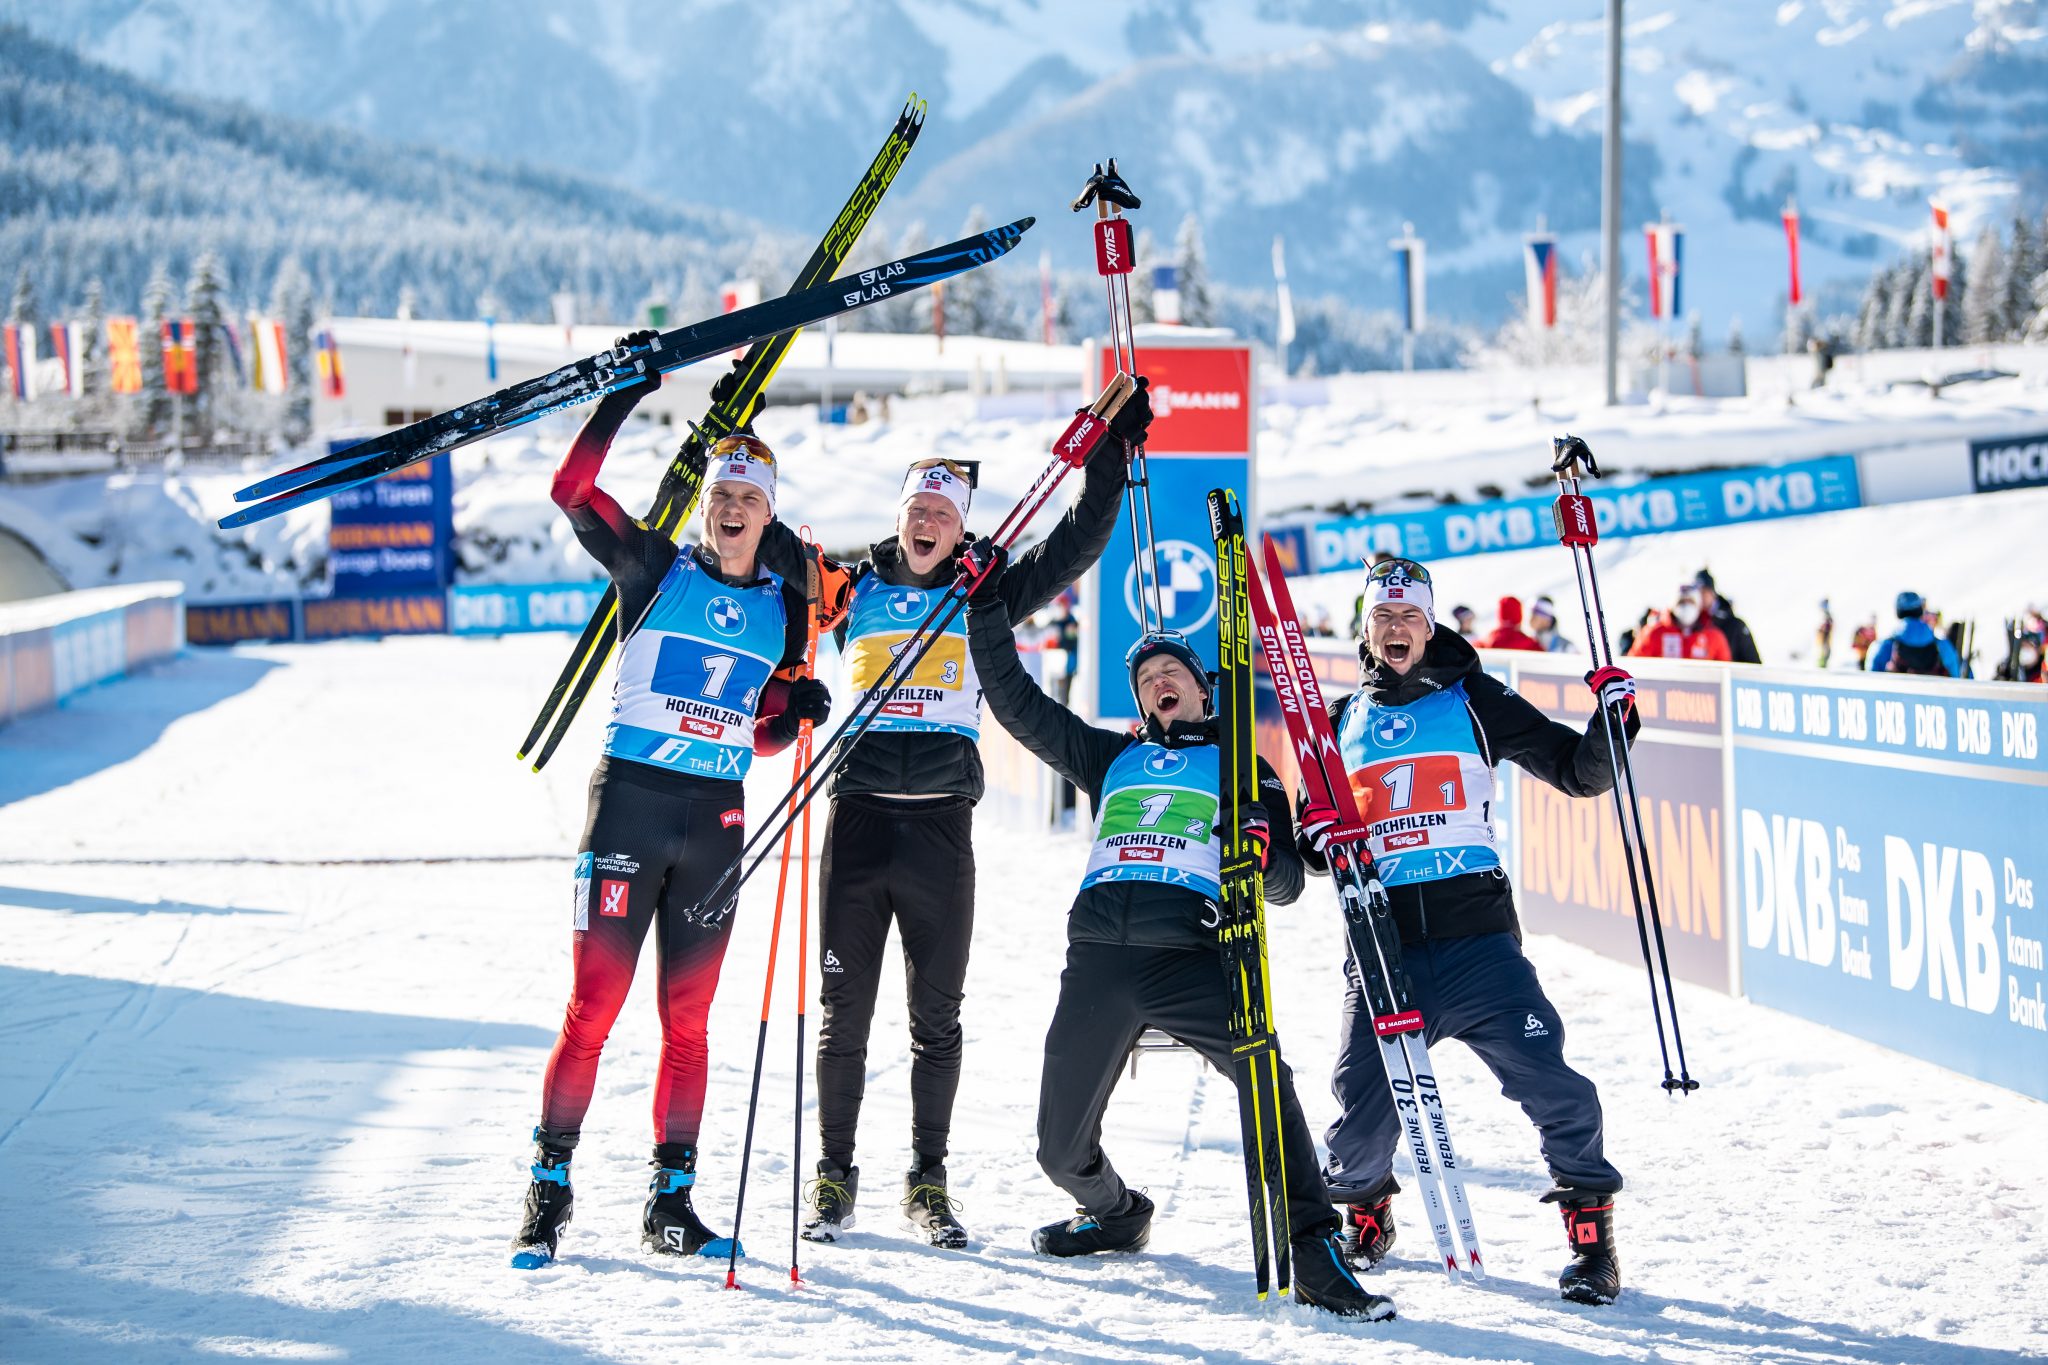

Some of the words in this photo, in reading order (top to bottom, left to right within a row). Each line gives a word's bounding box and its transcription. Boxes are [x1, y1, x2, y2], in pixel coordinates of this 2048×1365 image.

[823, 132, 899, 255] FISCHER
[834, 140, 910, 264] FISCHER
[1597, 488, 1679, 534] DKB
[1722, 472, 1816, 518] DKB
[1313, 523, 1402, 568] DKB
[1444, 507, 1534, 553] DKB
[1216, 537, 1233, 671] FISCHER
[1232, 533, 1249, 666] FISCHER
[702, 654, 738, 700] 1
[889, 638, 924, 680] 1
[940, 661, 958, 684] 3
[1260, 625, 1300, 713] MADSHUS
[1283, 620, 1322, 709] MADSHUS
[665, 698, 744, 727] HOCHFILZEN
[741, 686, 758, 711] 4
[1736, 687, 1763, 729] DKB
[1768, 690, 1796, 733] DKB
[1801, 693, 1831, 737] DKB
[1837, 696, 1868, 741] DKB
[1875, 699, 1906, 745] DKB
[1914, 703, 1948, 750] DKB
[1956, 707, 1992, 755] DKB
[2001, 711, 2038, 760] DKB
[689, 757, 714, 772] THE
[1380, 763, 1414, 812] 1
[1138, 793, 1175, 828] 1
[1439, 781, 1455, 806] 1
[1482, 800, 1490, 823] 1
[1106, 834, 1187, 850] HOCHFILZEN
[1184, 818, 1207, 837] 2
[1333, 827, 1366, 837] MADSHUS
[1836, 825, 1861, 873] Das
[1130, 871, 1159, 881] THE
[1219, 860, 1253, 873] FISCHER
[1404, 866, 1433, 880] THE
[1741, 808, 1836, 967] DKB
[2003, 856, 2034, 910] Das
[1884, 834, 2001, 1015] DKB
[2005, 915, 2044, 971] kann
[1840, 930, 1872, 980] Bank
[1387, 1016, 1420, 1028] MADSHUS
[2008, 974, 2047, 1032] Bank
[1232, 1039, 1267, 1054] FISCHER
[1391, 1078, 1419, 1114] 3.0
[1415, 1074, 1443, 1109] 3.0
[1406, 1117, 1432, 1175] REDLINE
[1430, 1112, 1456, 1170] REDLINE
